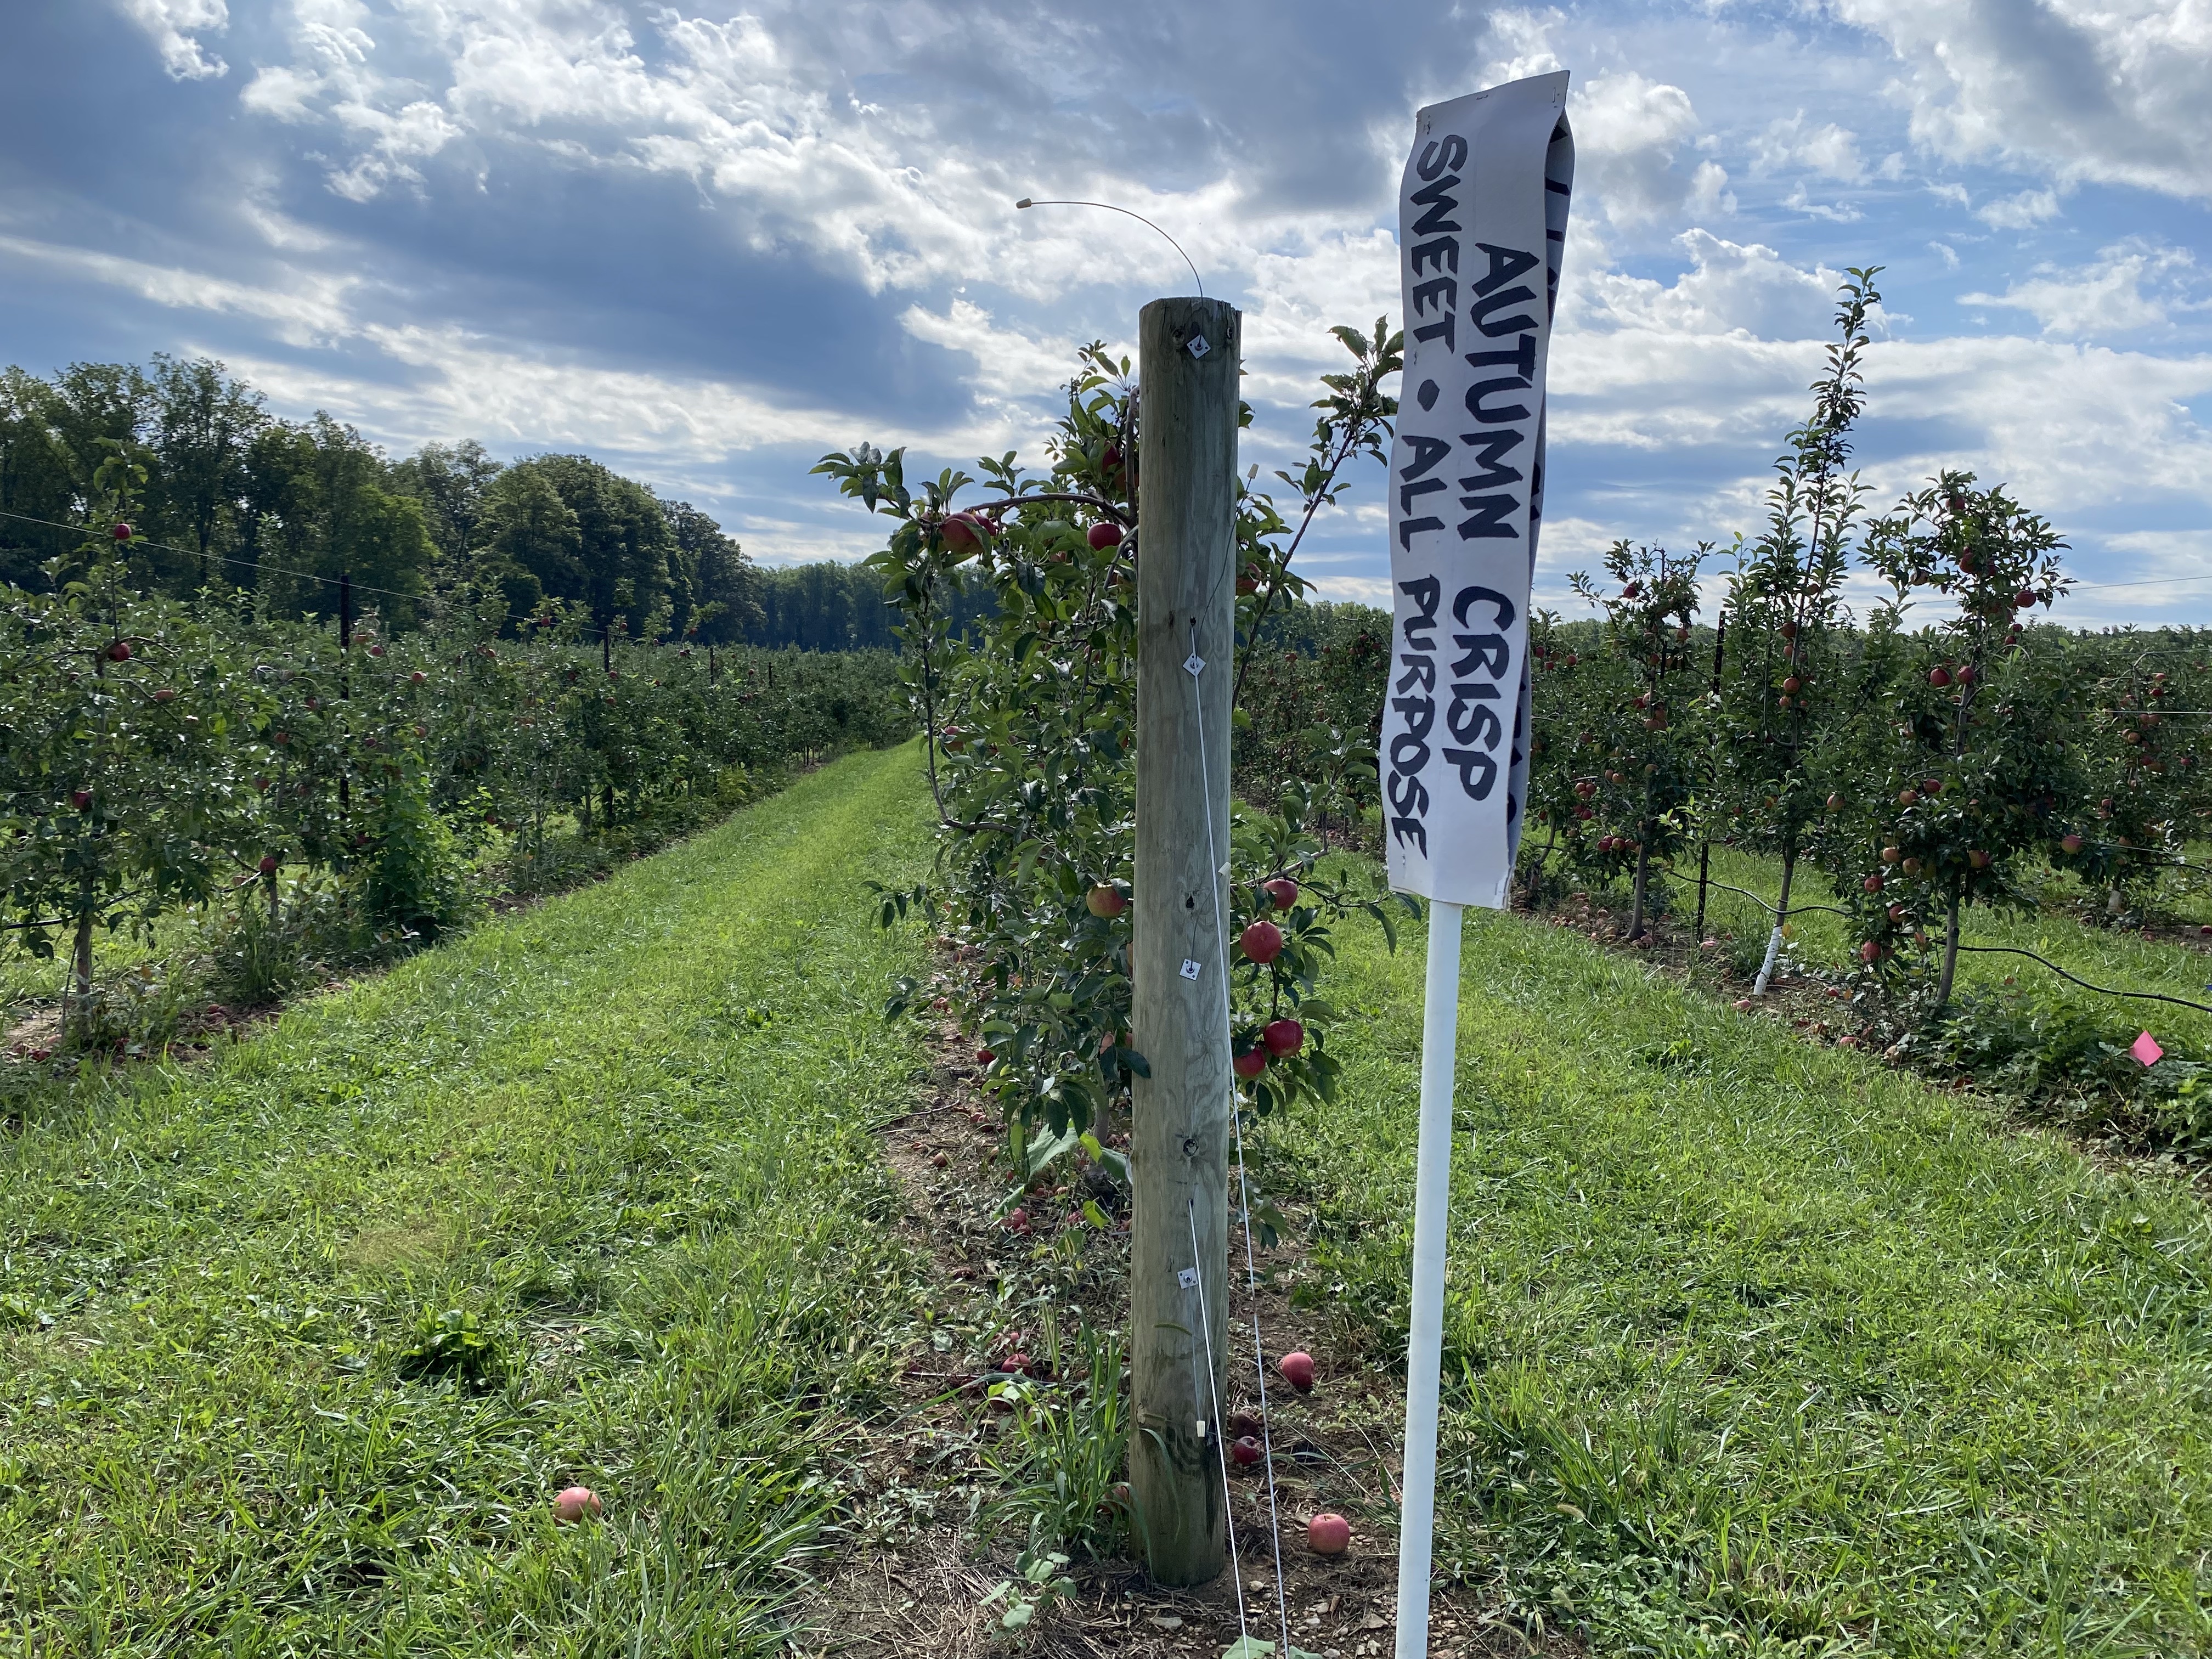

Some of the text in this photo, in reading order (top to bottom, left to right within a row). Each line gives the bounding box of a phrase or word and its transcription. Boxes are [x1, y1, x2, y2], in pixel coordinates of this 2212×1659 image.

[1387, 134, 1468, 860] SWEET ALL PURPOSE
[1442, 242, 1540, 802] AUTUMN CRISP
